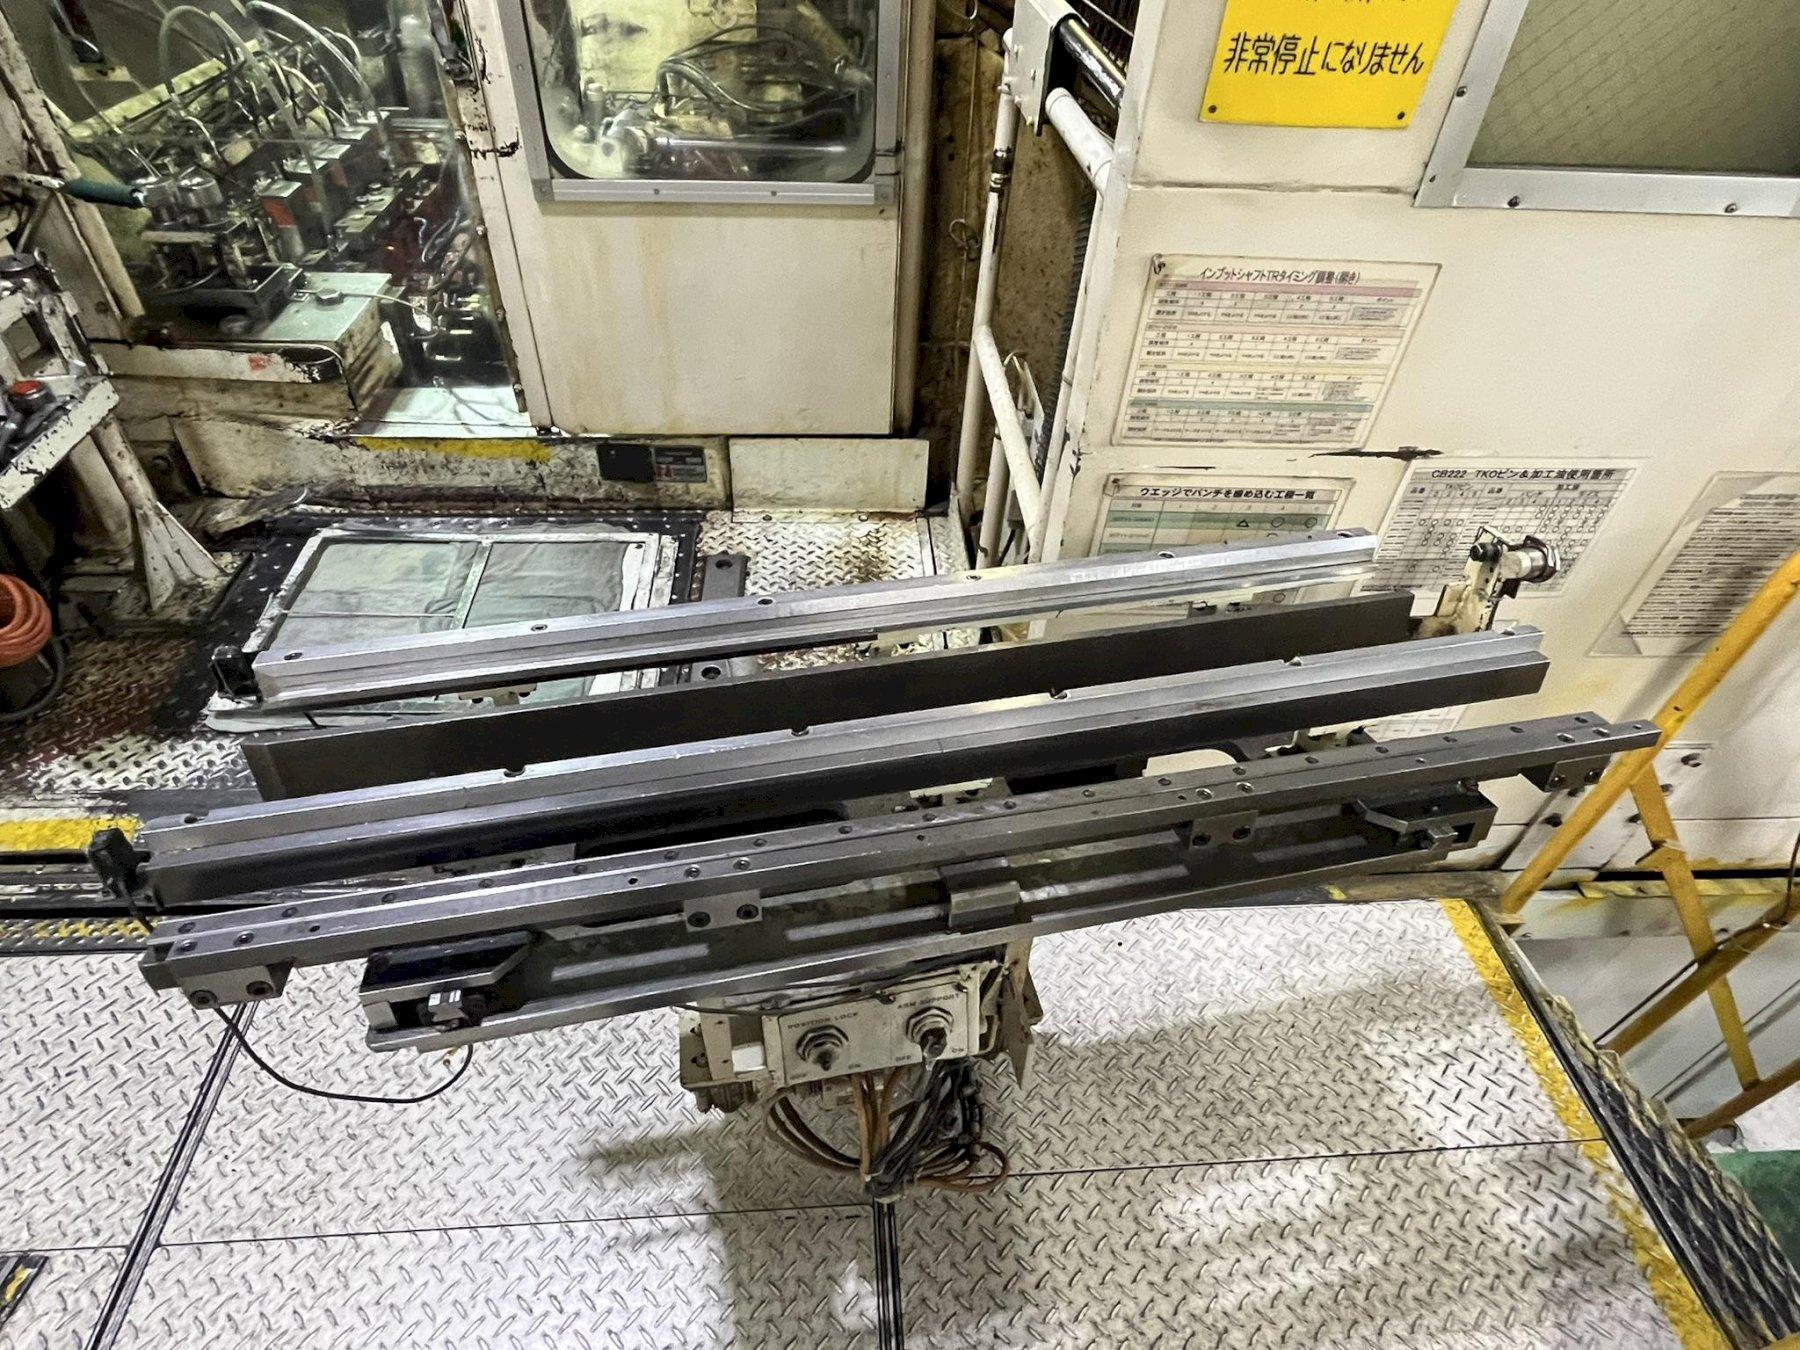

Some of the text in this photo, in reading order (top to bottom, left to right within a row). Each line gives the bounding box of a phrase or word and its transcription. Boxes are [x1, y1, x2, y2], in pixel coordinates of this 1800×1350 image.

[1223, 31, 1425, 76] 非常停止になりません
[1431, 469, 1468, 479] CB222
[786, 1012, 859, 1030] POSITION LOCK
